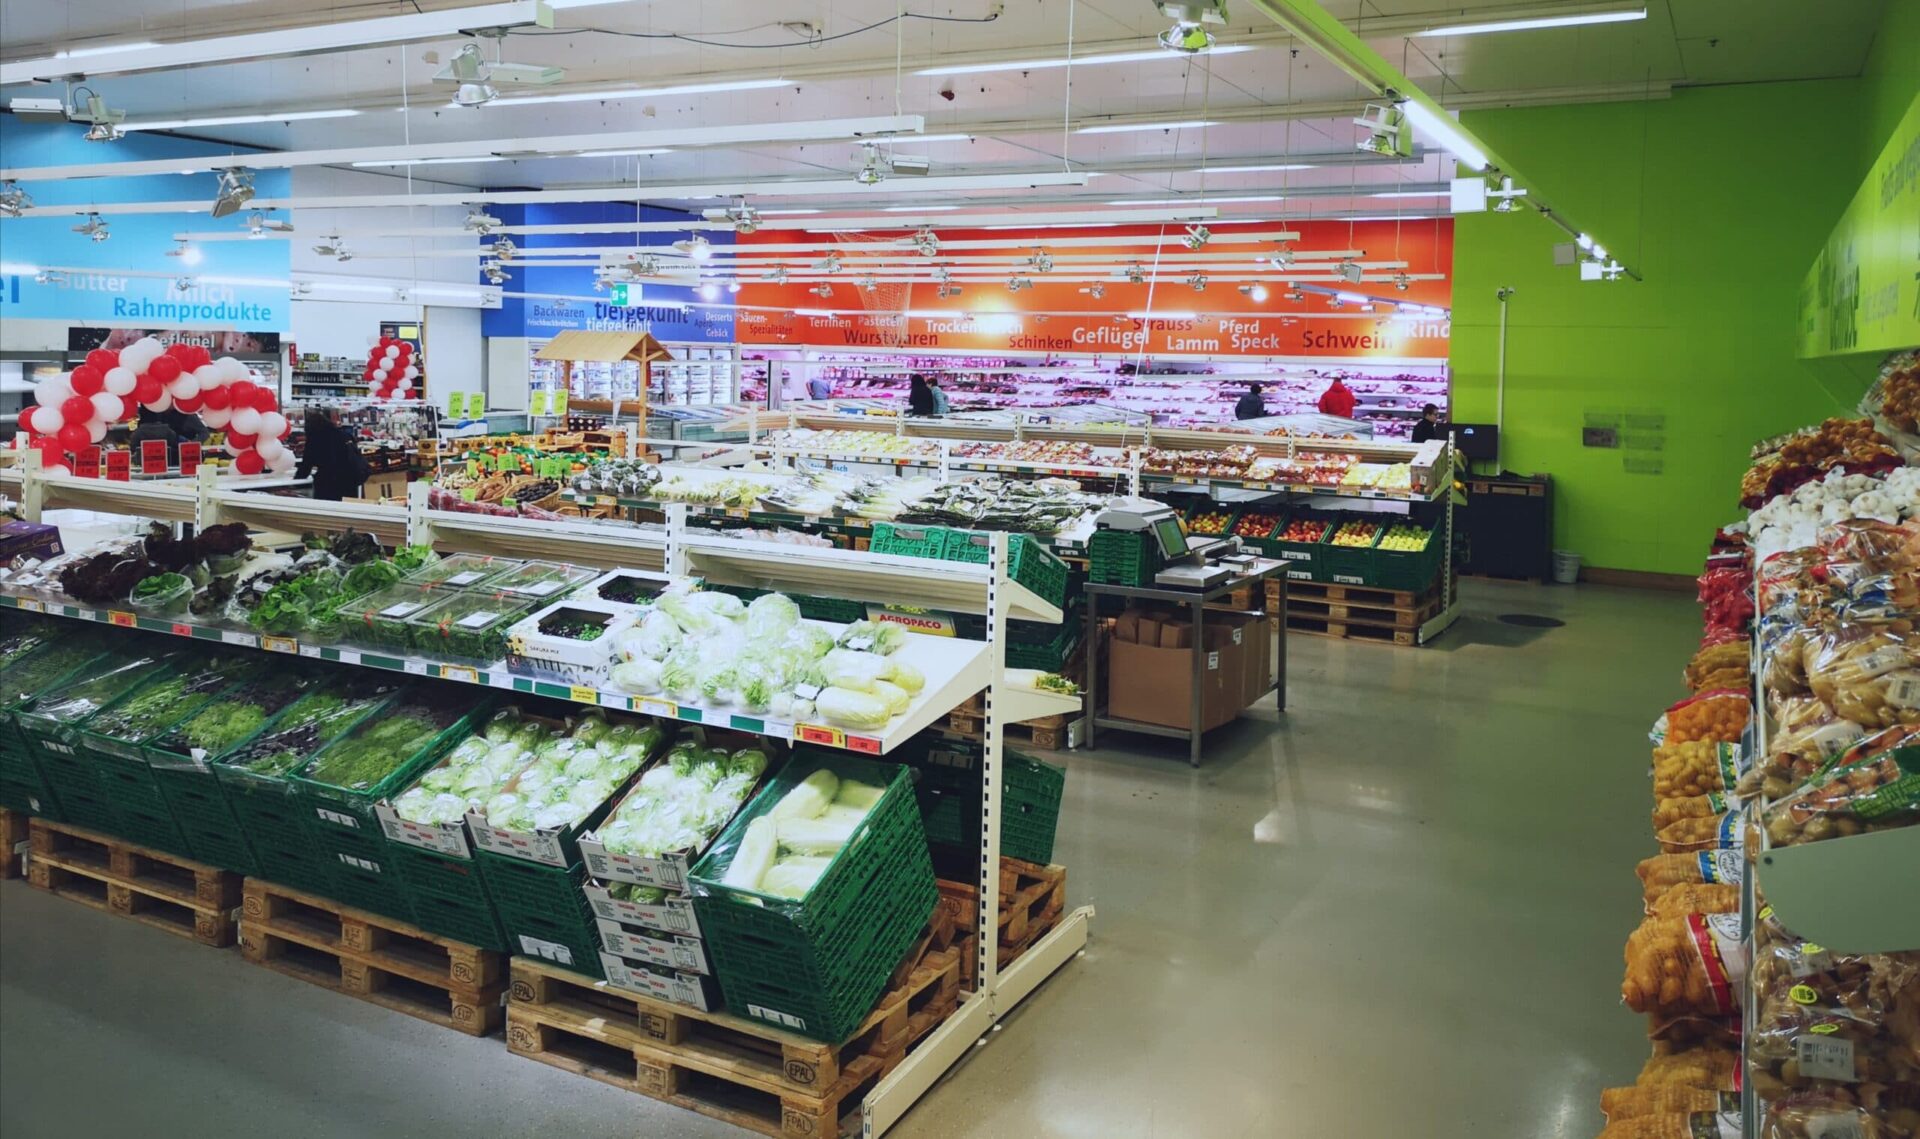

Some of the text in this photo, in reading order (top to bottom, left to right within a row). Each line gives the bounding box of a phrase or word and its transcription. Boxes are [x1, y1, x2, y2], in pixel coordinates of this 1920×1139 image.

[114, 297, 272, 322] Rahmprodukte
[534, 305, 585, 318] Backwaren
[706, 312, 732, 322] Desserts
[706, 328, 728, 338] Gebäck
[750, 323, 793, 336] Spezialitäten
[1219, 319, 1260, 334] Pferd
[1009, 335, 1073, 349] Schinken
[1072, 327, 1150, 349] Geflügel
[1167, 335, 1219, 351] Lamm
[1231, 333, 1280, 352] Speck
[1302, 329, 1393, 349] Schwein
[880, 614, 942, 630] AGROPACO
